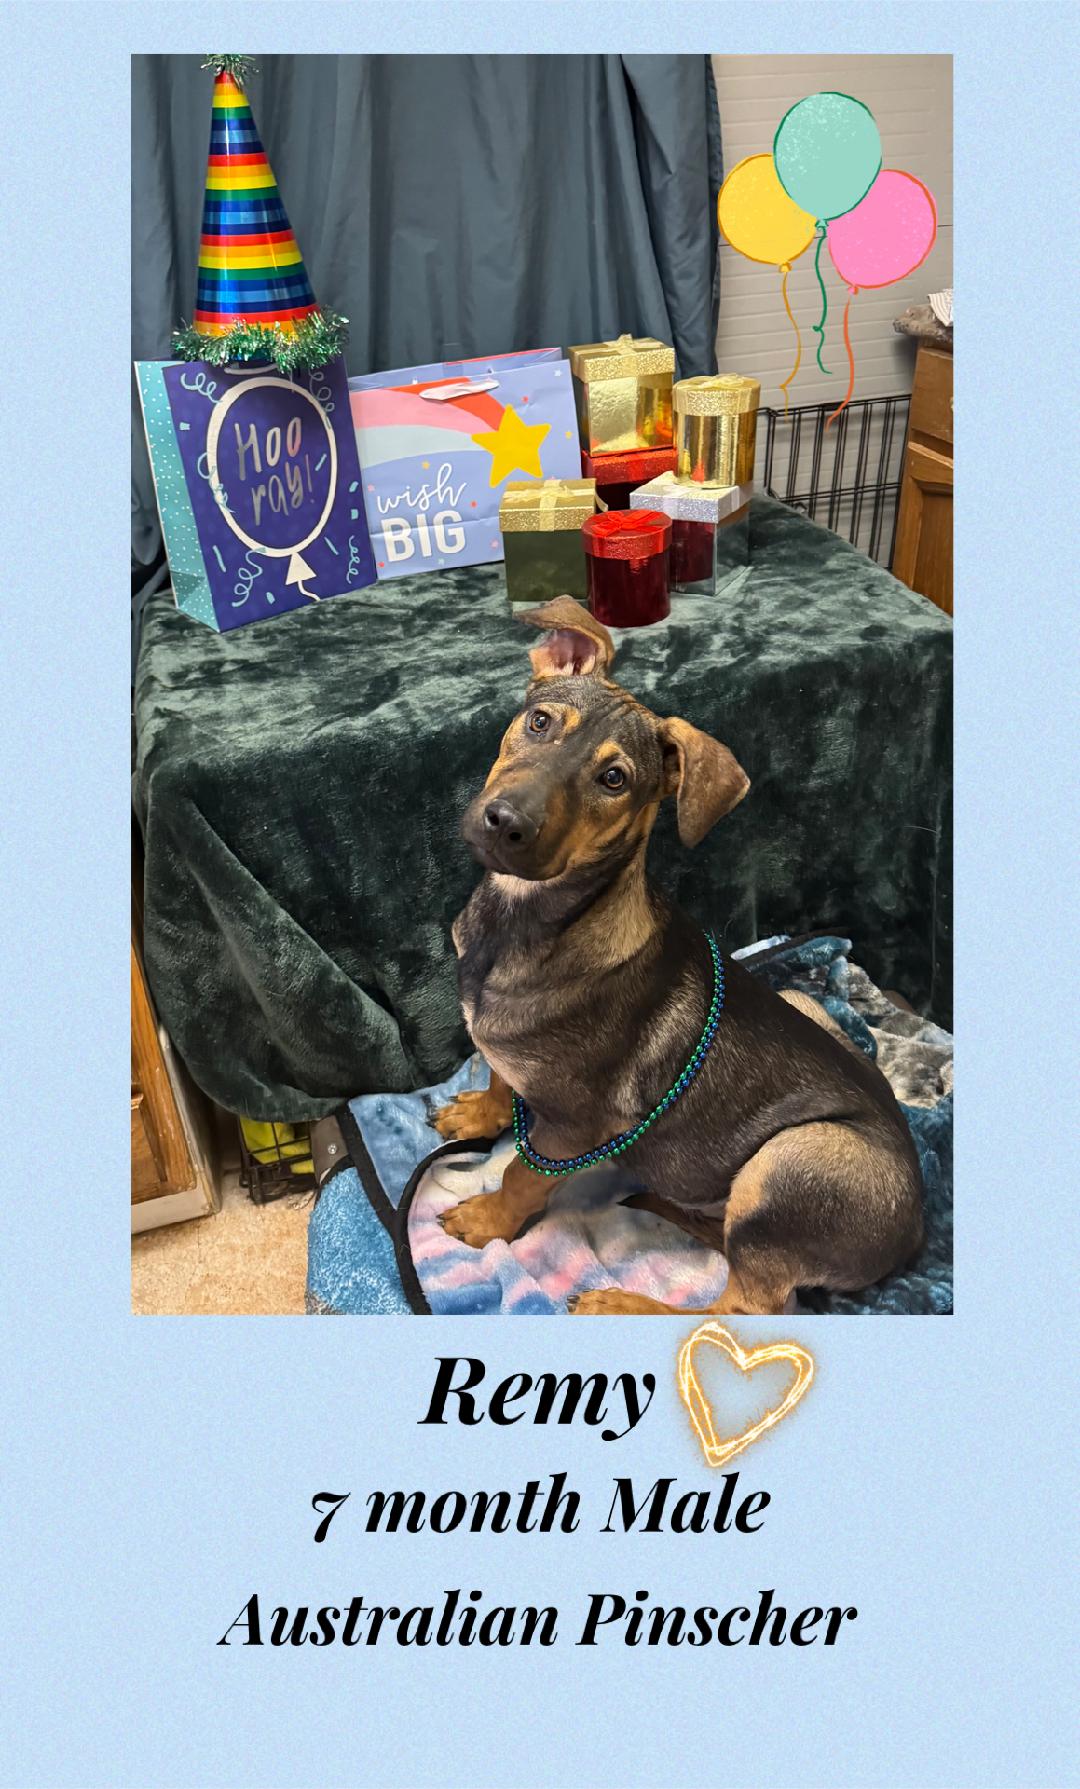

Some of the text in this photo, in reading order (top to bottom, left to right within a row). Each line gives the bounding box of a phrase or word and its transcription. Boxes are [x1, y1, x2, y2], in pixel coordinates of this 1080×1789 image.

[251, 454, 315, 526] ray!
[377, 463, 467, 514] wish
[380, 510, 467, 562] BIG
